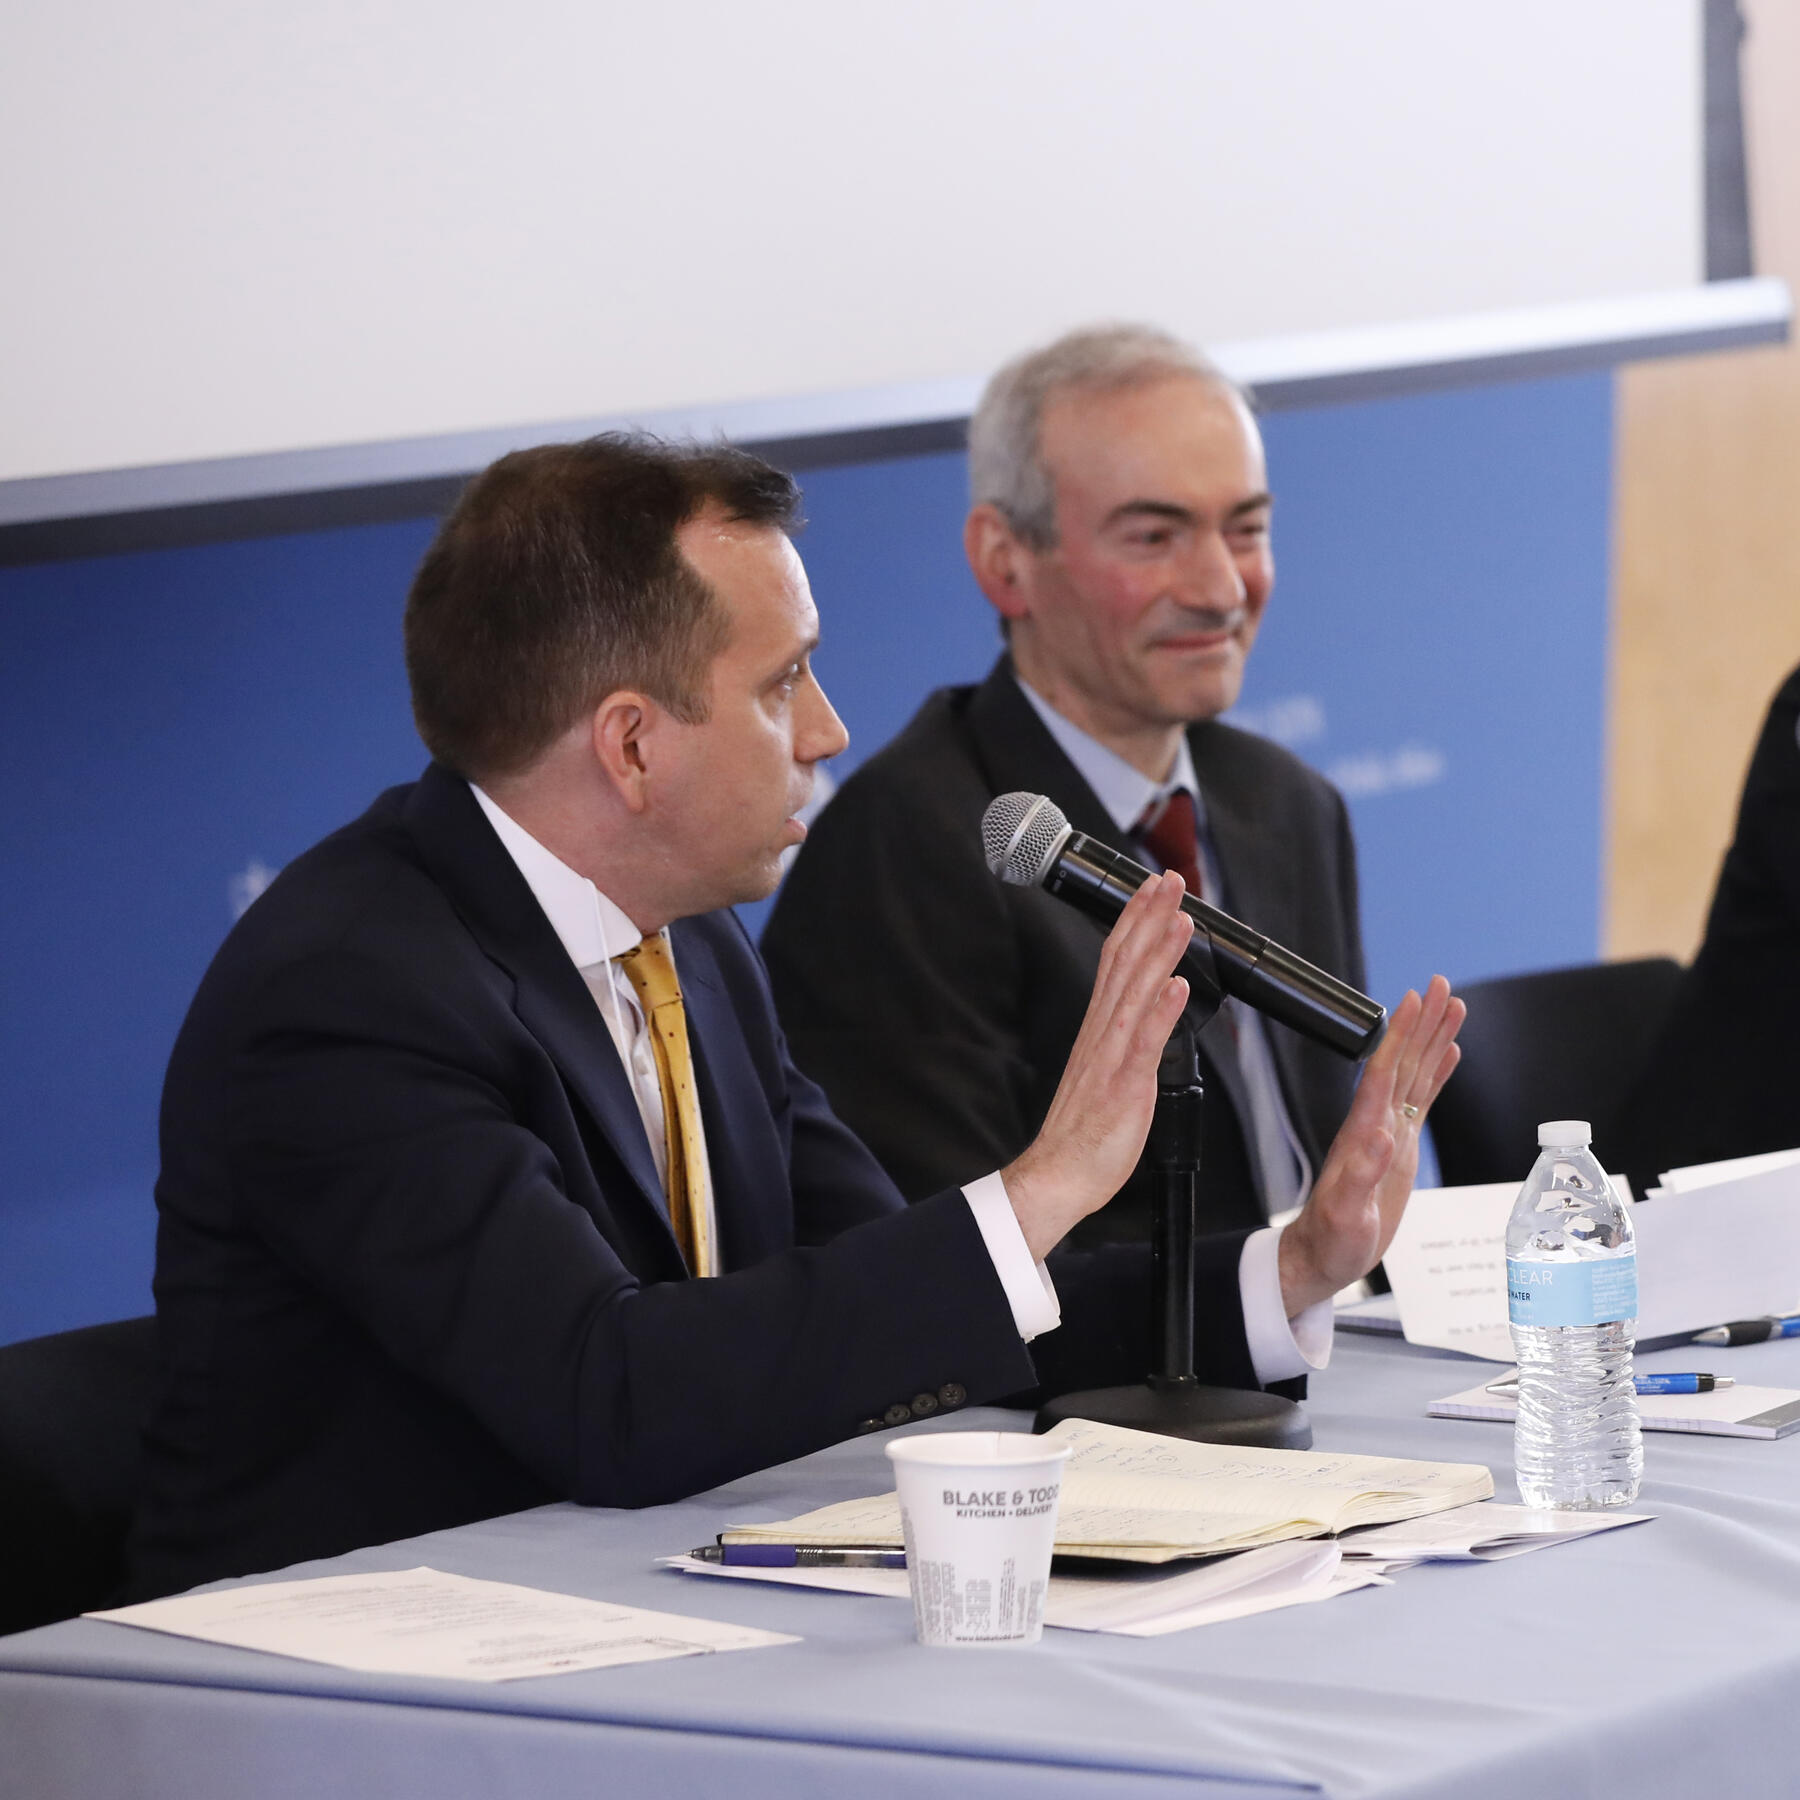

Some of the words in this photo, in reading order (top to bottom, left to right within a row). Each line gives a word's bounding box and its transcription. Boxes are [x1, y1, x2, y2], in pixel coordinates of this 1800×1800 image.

[1511, 1290, 1531, 1301] WATER
[943, 1489, 1007, 1506] BLAKE
[1012, 1490, 1024, 1506] &
[956, 1508, 1006, 1519] KITCHEN
